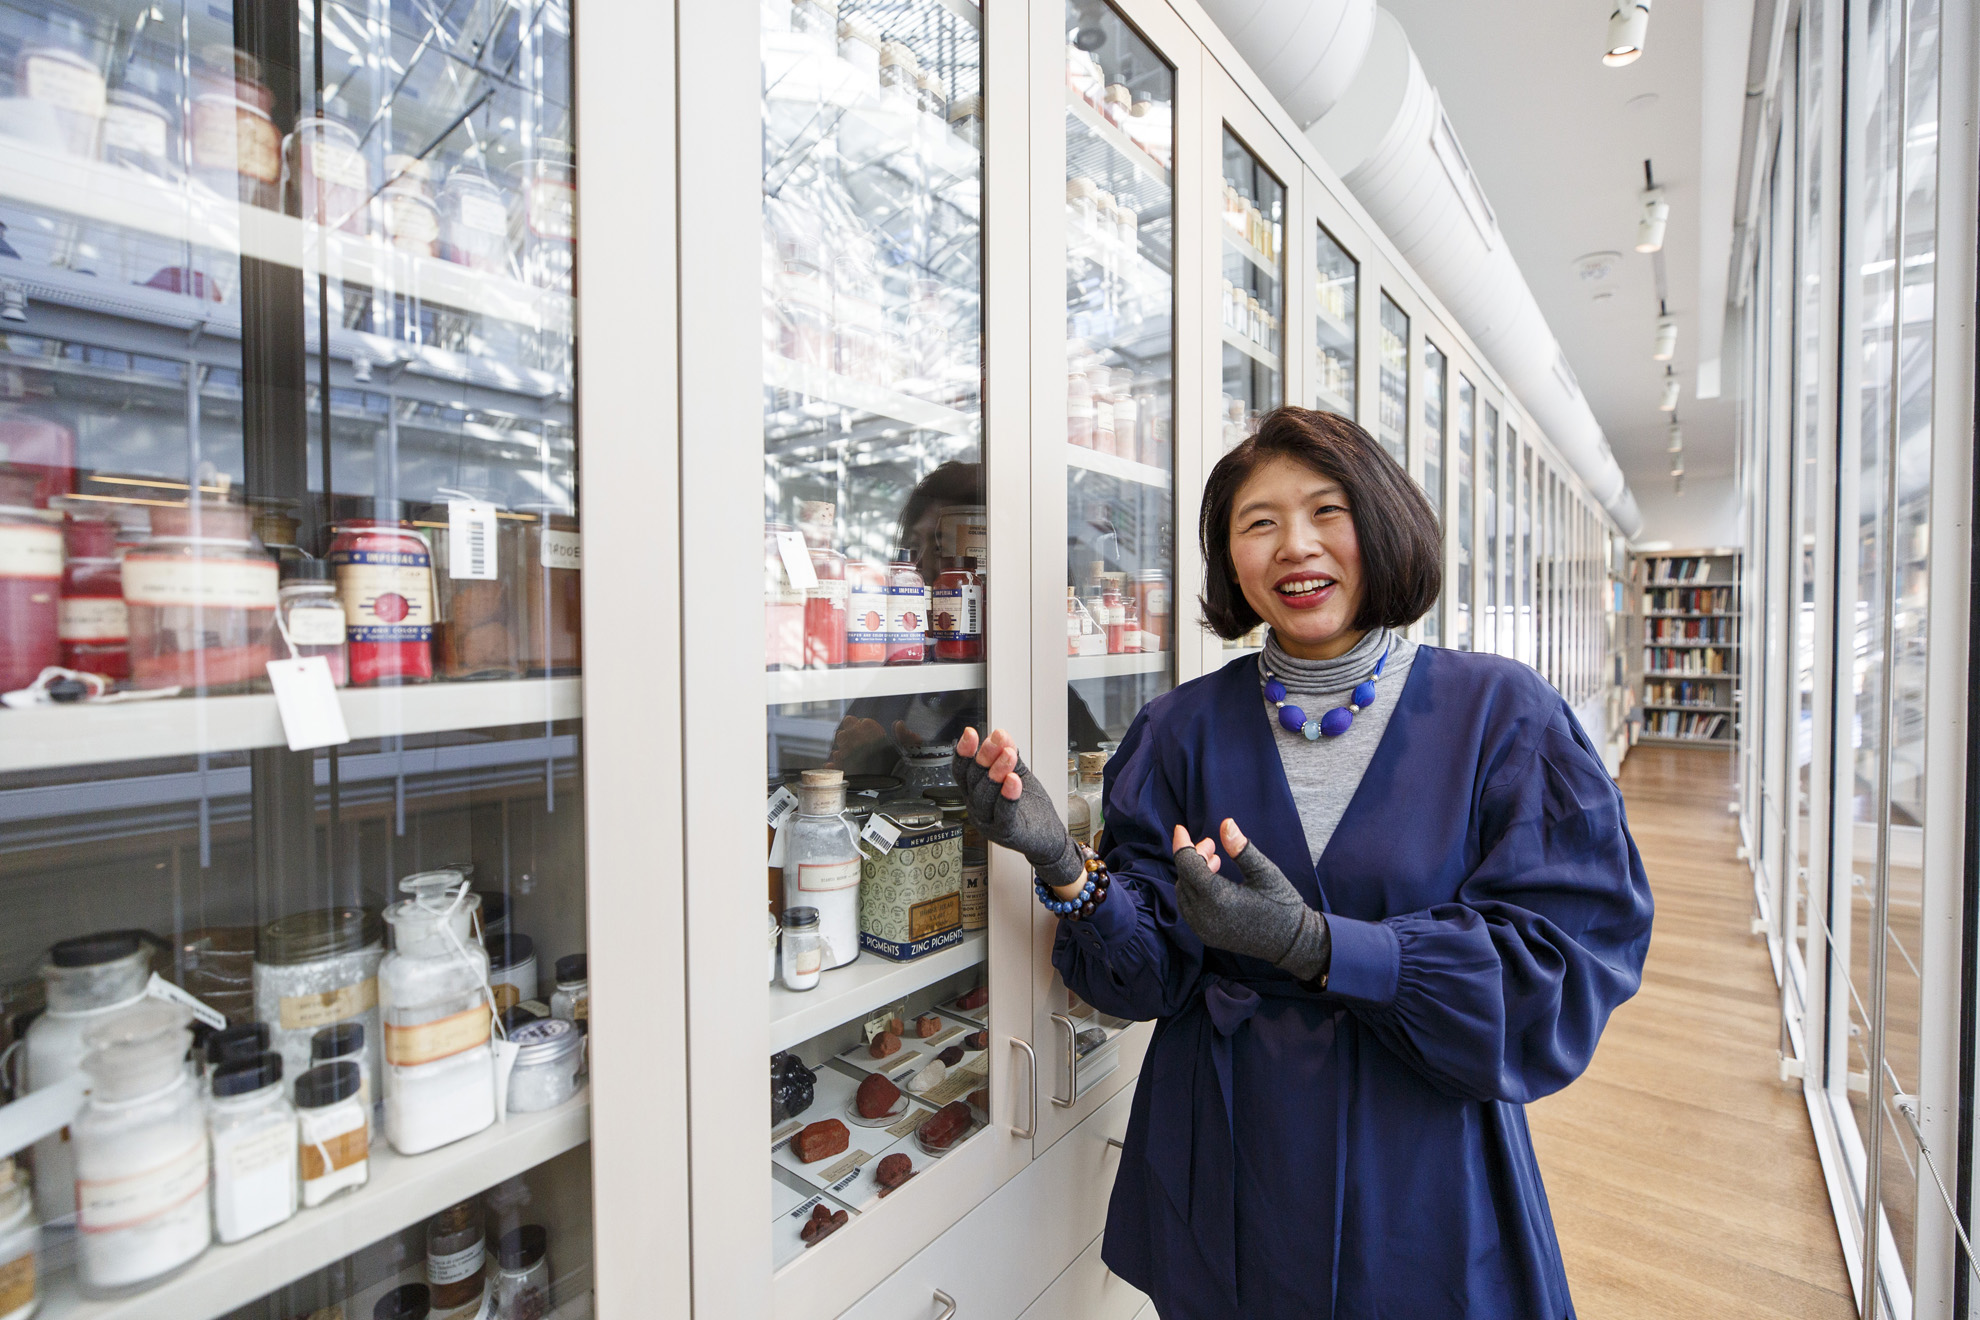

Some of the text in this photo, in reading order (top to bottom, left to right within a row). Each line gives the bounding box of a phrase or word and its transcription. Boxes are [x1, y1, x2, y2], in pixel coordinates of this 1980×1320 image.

[366, 553, 414, 564] IMPERIAL
[910, 837, 925, 846] NEW
[926, 832, 949, 843] JERSEY
[950, 828, 963, 837] ZINC
[866, 936, 900, 956] PIGMENTS
[911, 928, 963, 955] ZINC PIGMENTS
